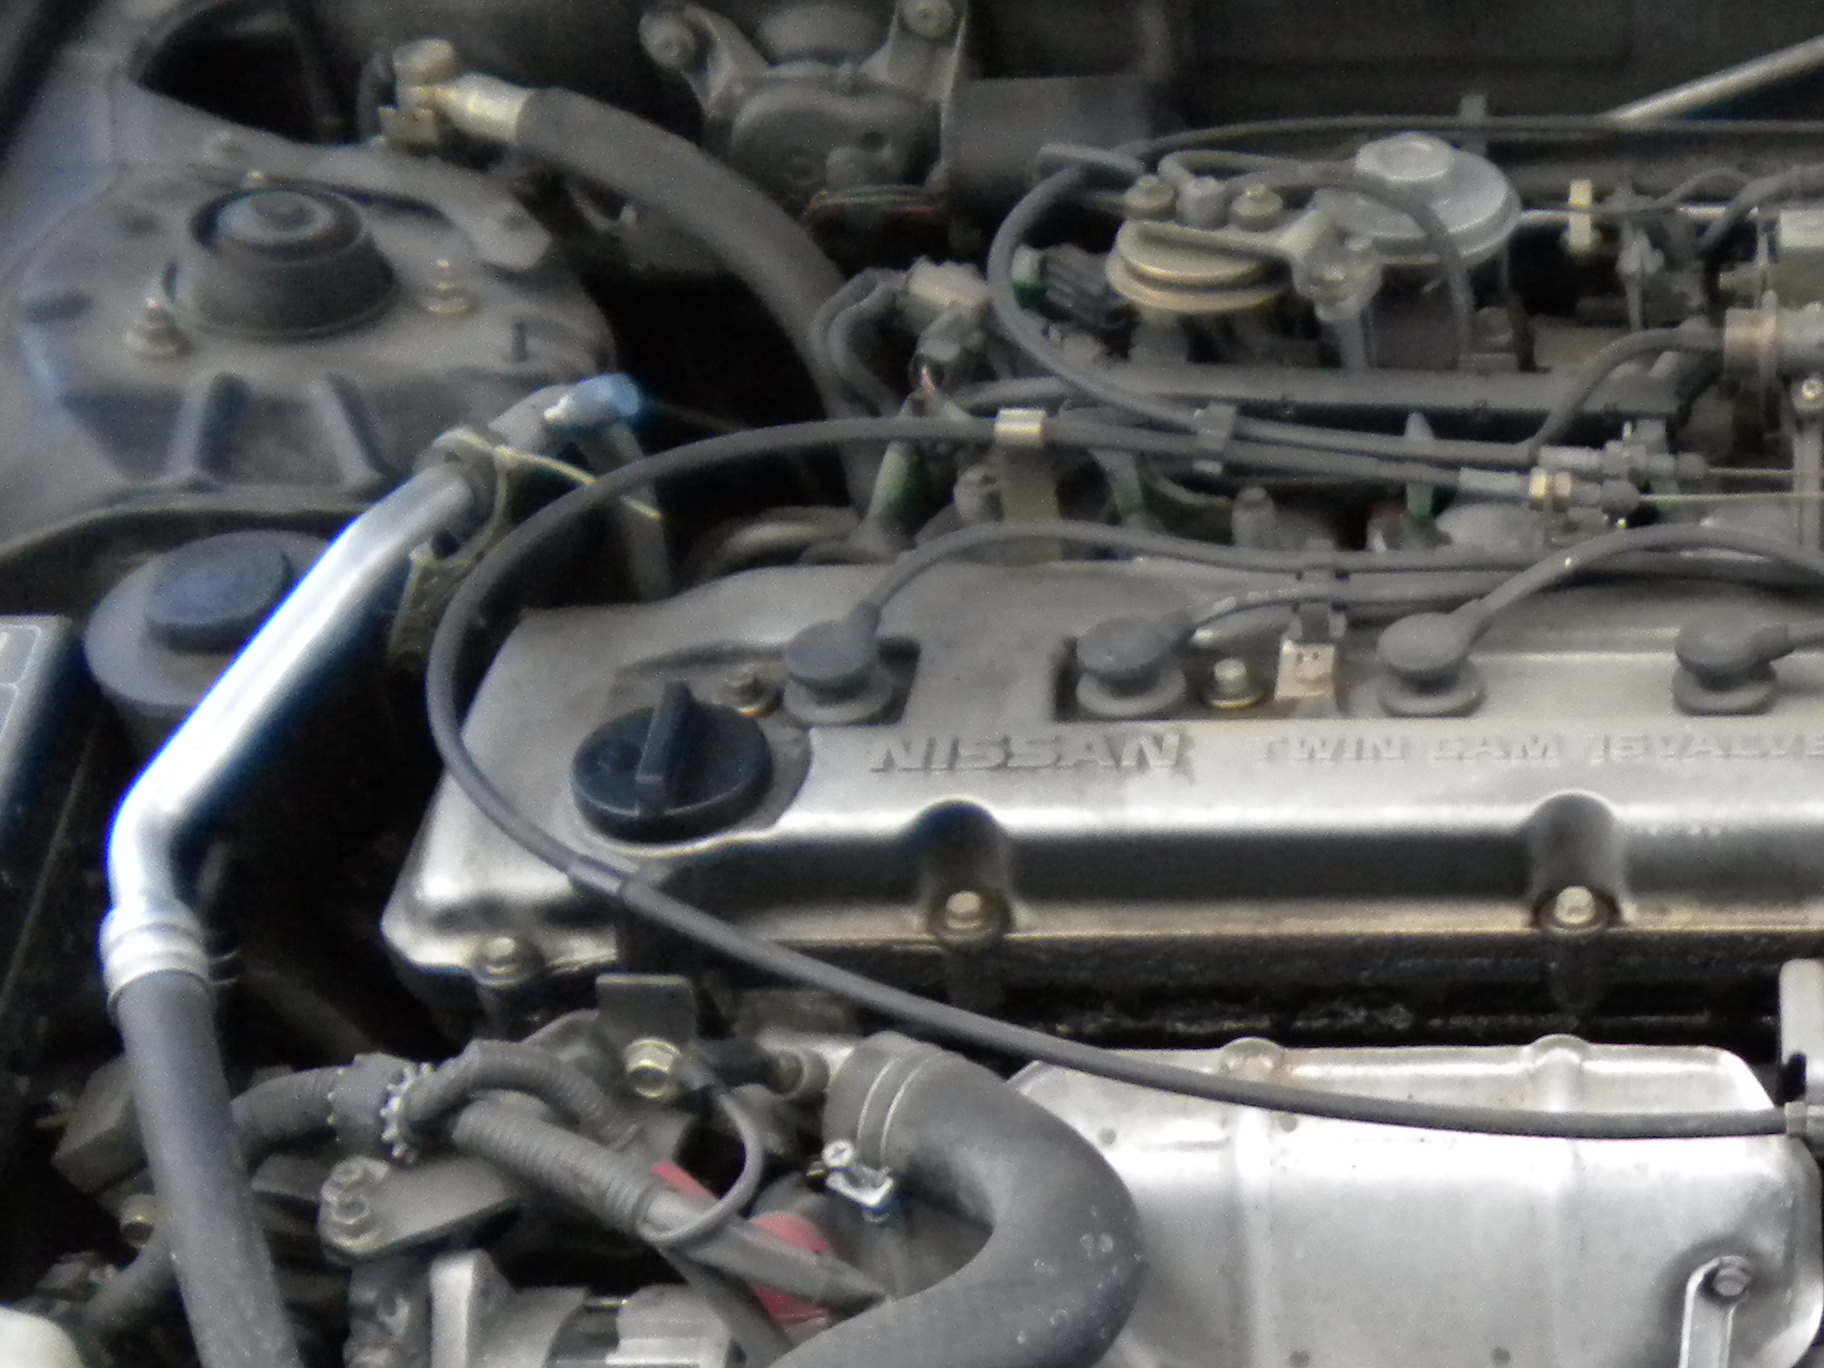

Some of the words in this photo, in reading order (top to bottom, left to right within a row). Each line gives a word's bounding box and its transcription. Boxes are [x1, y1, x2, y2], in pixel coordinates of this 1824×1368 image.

[868, 734, 1193, 771] NISSAN
[1247, 735, 1408, 761] TWIN
[1434, 735, 1562, 761] CAM
